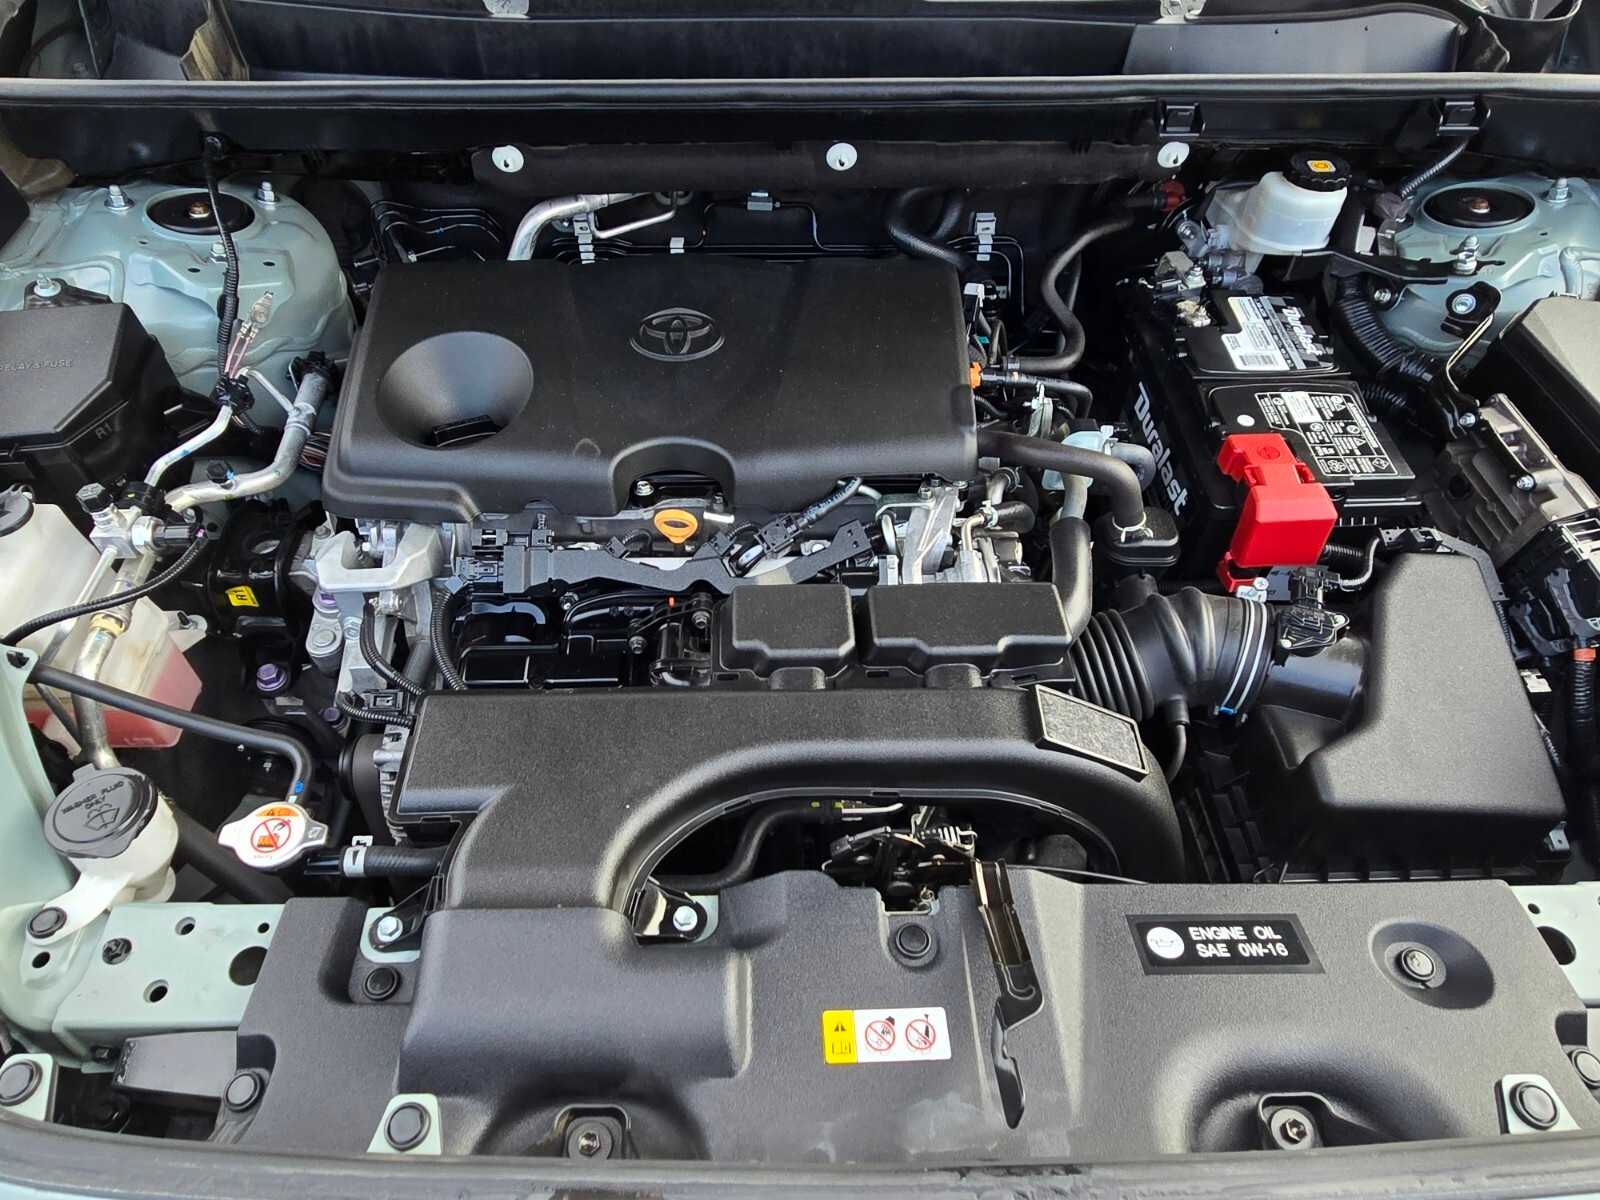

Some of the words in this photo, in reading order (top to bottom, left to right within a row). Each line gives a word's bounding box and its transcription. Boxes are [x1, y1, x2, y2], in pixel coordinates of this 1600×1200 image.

[1281, 305, 1324, 357] Duralast
[1133, 382, 1190, 517] Duralast
[1188, 926, 1248, 941] ENGINE
[1253, 926, 1282, 940] OIL
[1195, 943, 1231, 957] SAE
[1238, 942, 1289, 957] 0W-16
